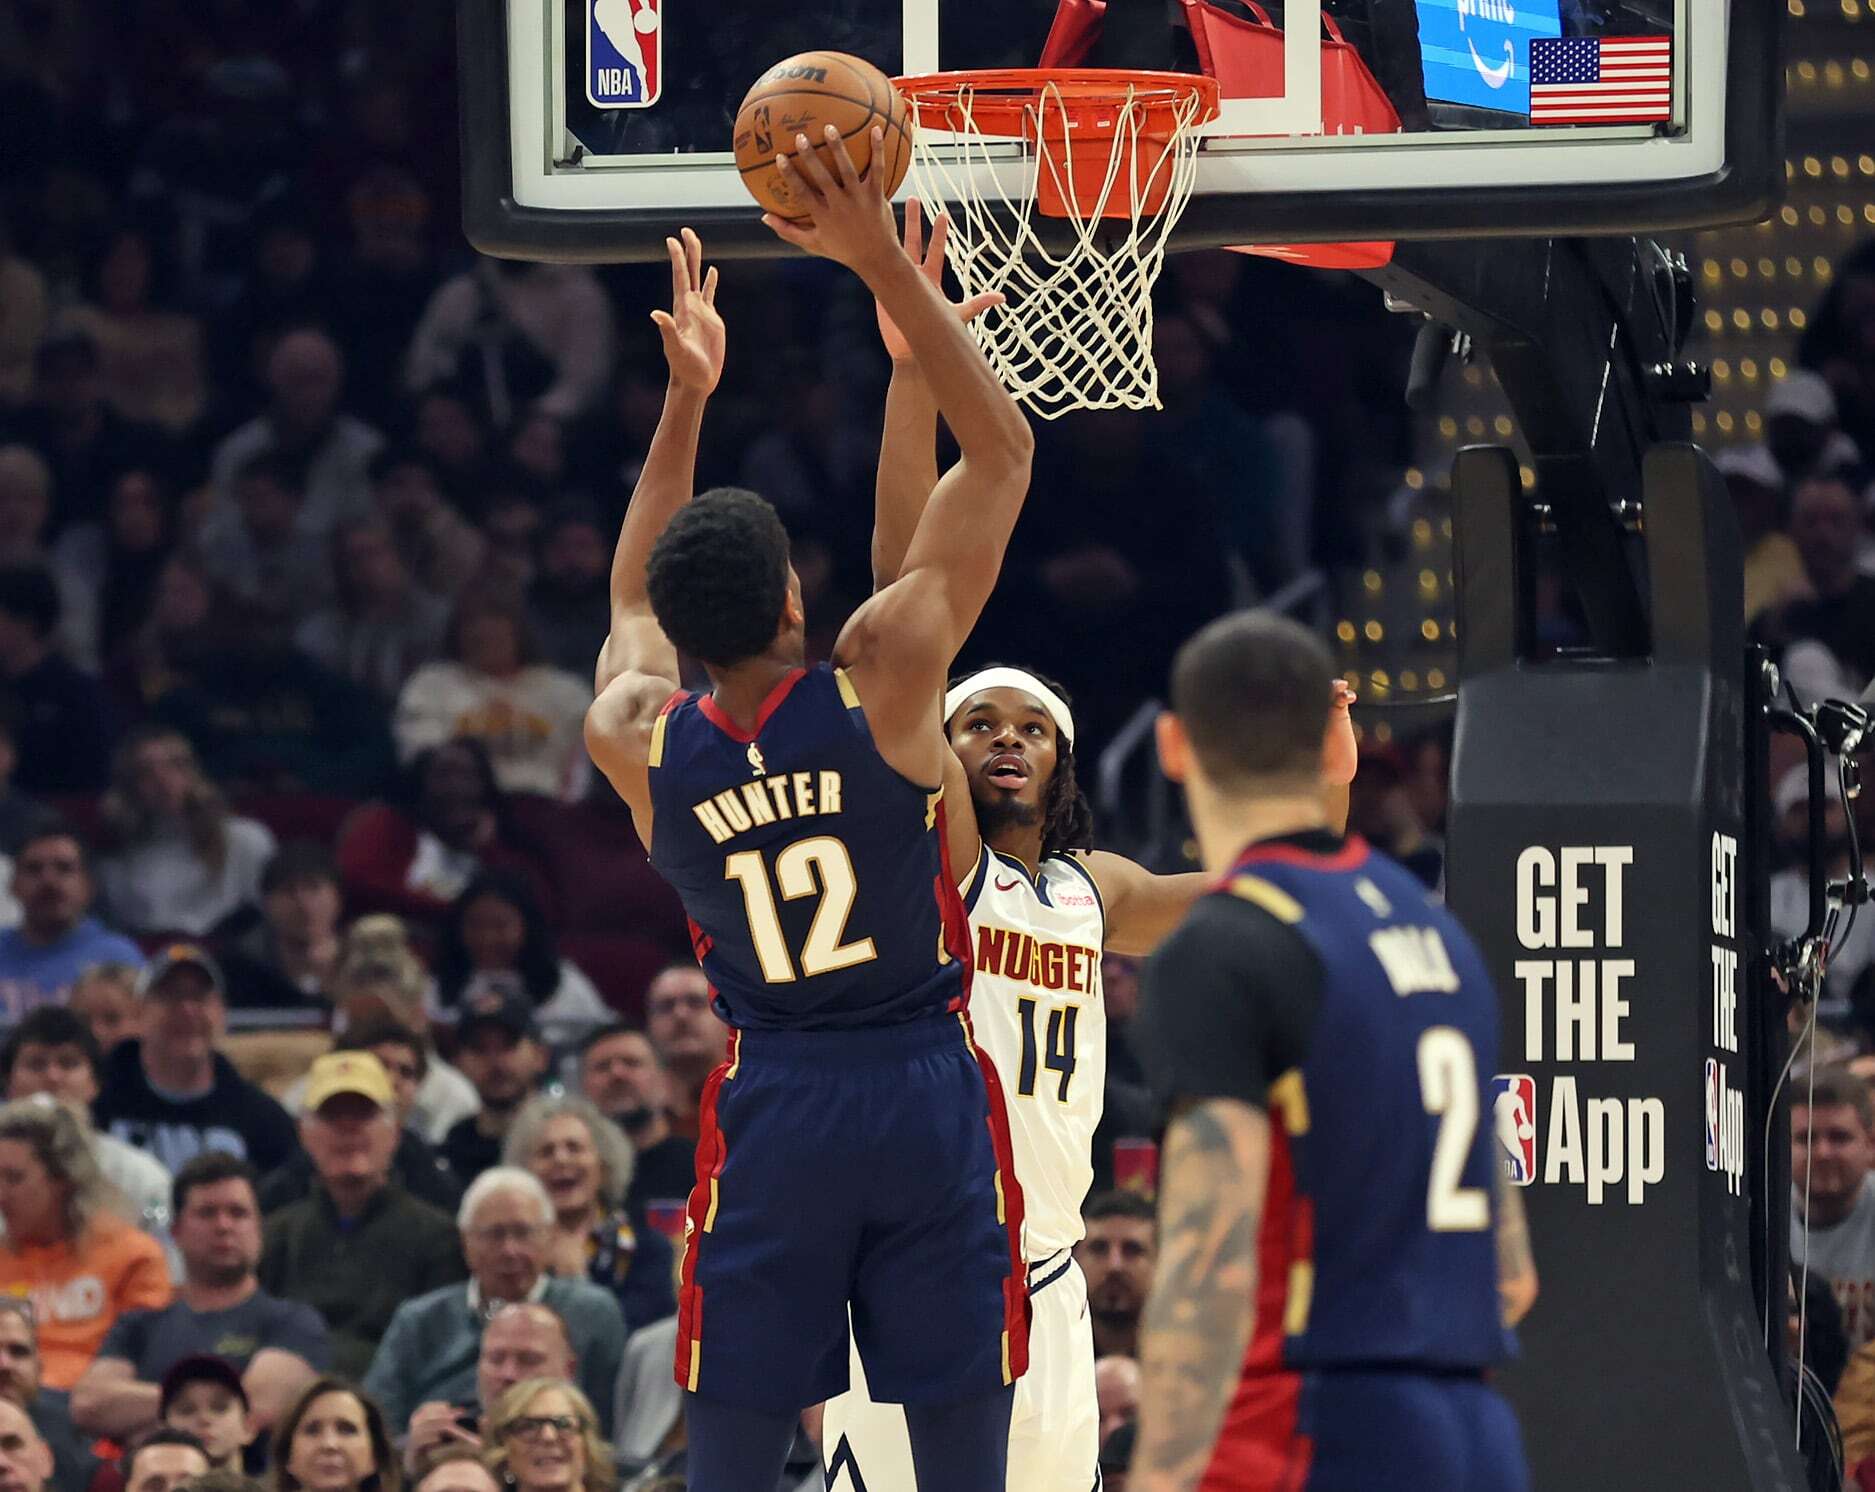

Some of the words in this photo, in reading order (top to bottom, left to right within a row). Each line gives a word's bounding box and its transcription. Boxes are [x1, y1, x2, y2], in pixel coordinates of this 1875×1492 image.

[598, 68, 633, 96] NBA
[692, 770, 842, 844] HUNTER
[724, 835, 878, 984] 12
[1516, 846, 1634, 949] GET
[1711, 830, 1737, 939] GET
[977, 925, 1098, 998] NUGGET
[1515, 959, 1635, 1062] THE
[1711, 944, 1738, 1053] THE
[1017, 996, 1080, 1103] 14
[1416, 1025, 1490, 1232] 2
[1544, 1075, 1665, 1205] App
[1719, 1063, 1744, 1197] App
